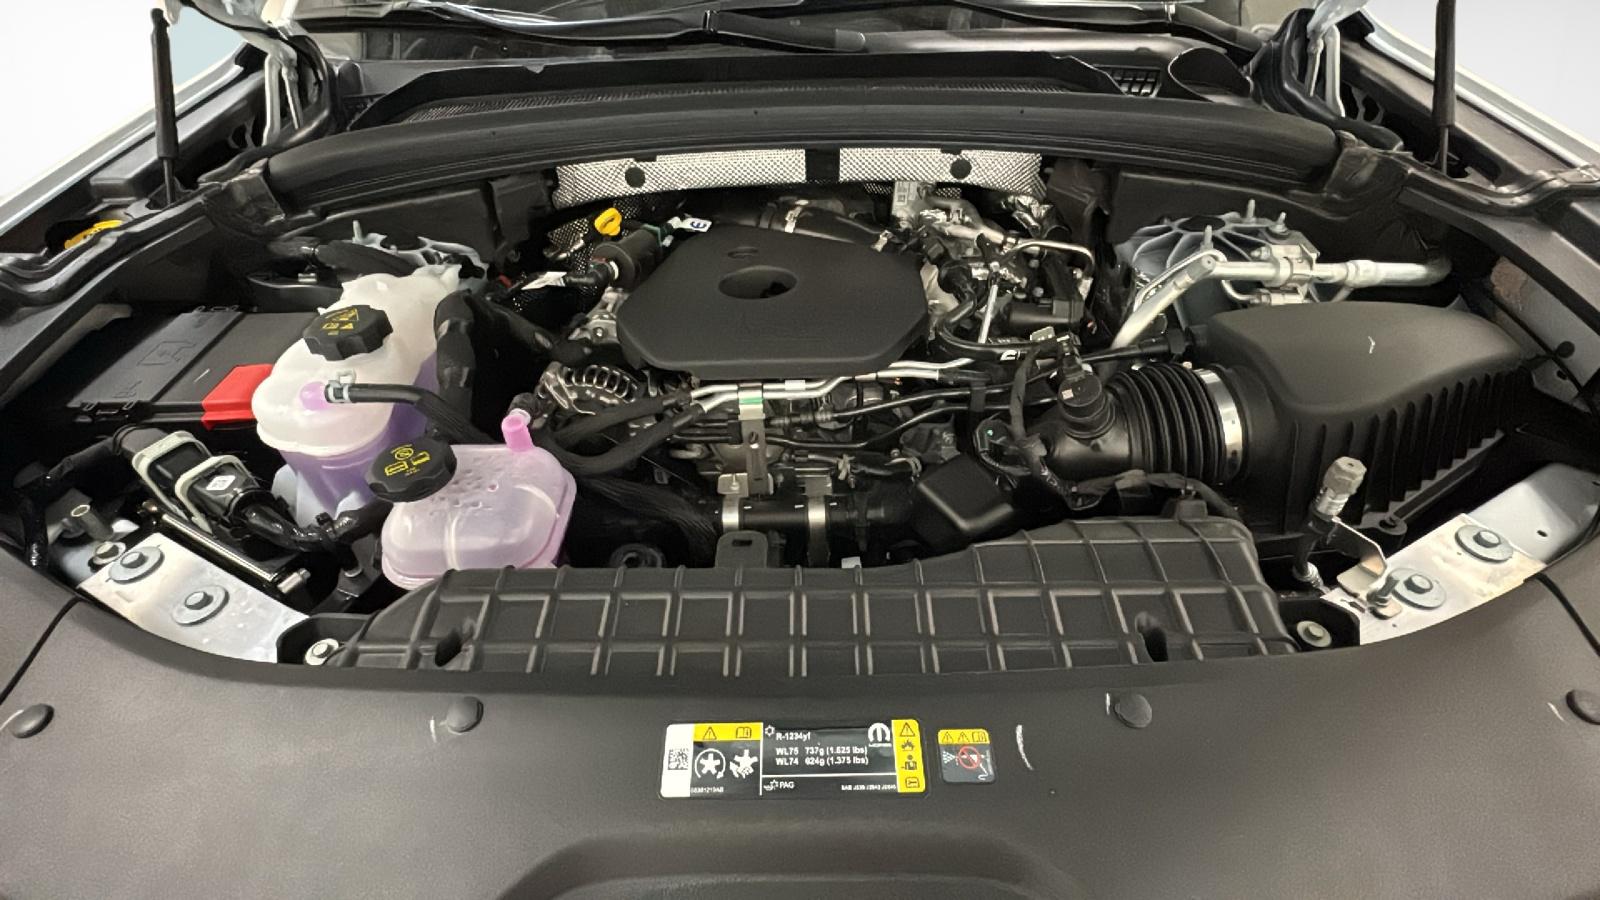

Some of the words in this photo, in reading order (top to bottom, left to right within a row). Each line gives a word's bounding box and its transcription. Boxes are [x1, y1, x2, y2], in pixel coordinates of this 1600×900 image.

[804, 746, 825, 757] 737g
[852, 745, 868, 757] lbs)
[775, 757, 799, 766] WL74
[826, 756, 851, 767] (1.375
[852, 756, 869, 766] lbs)
[779, 781, 795, 789] PAG
